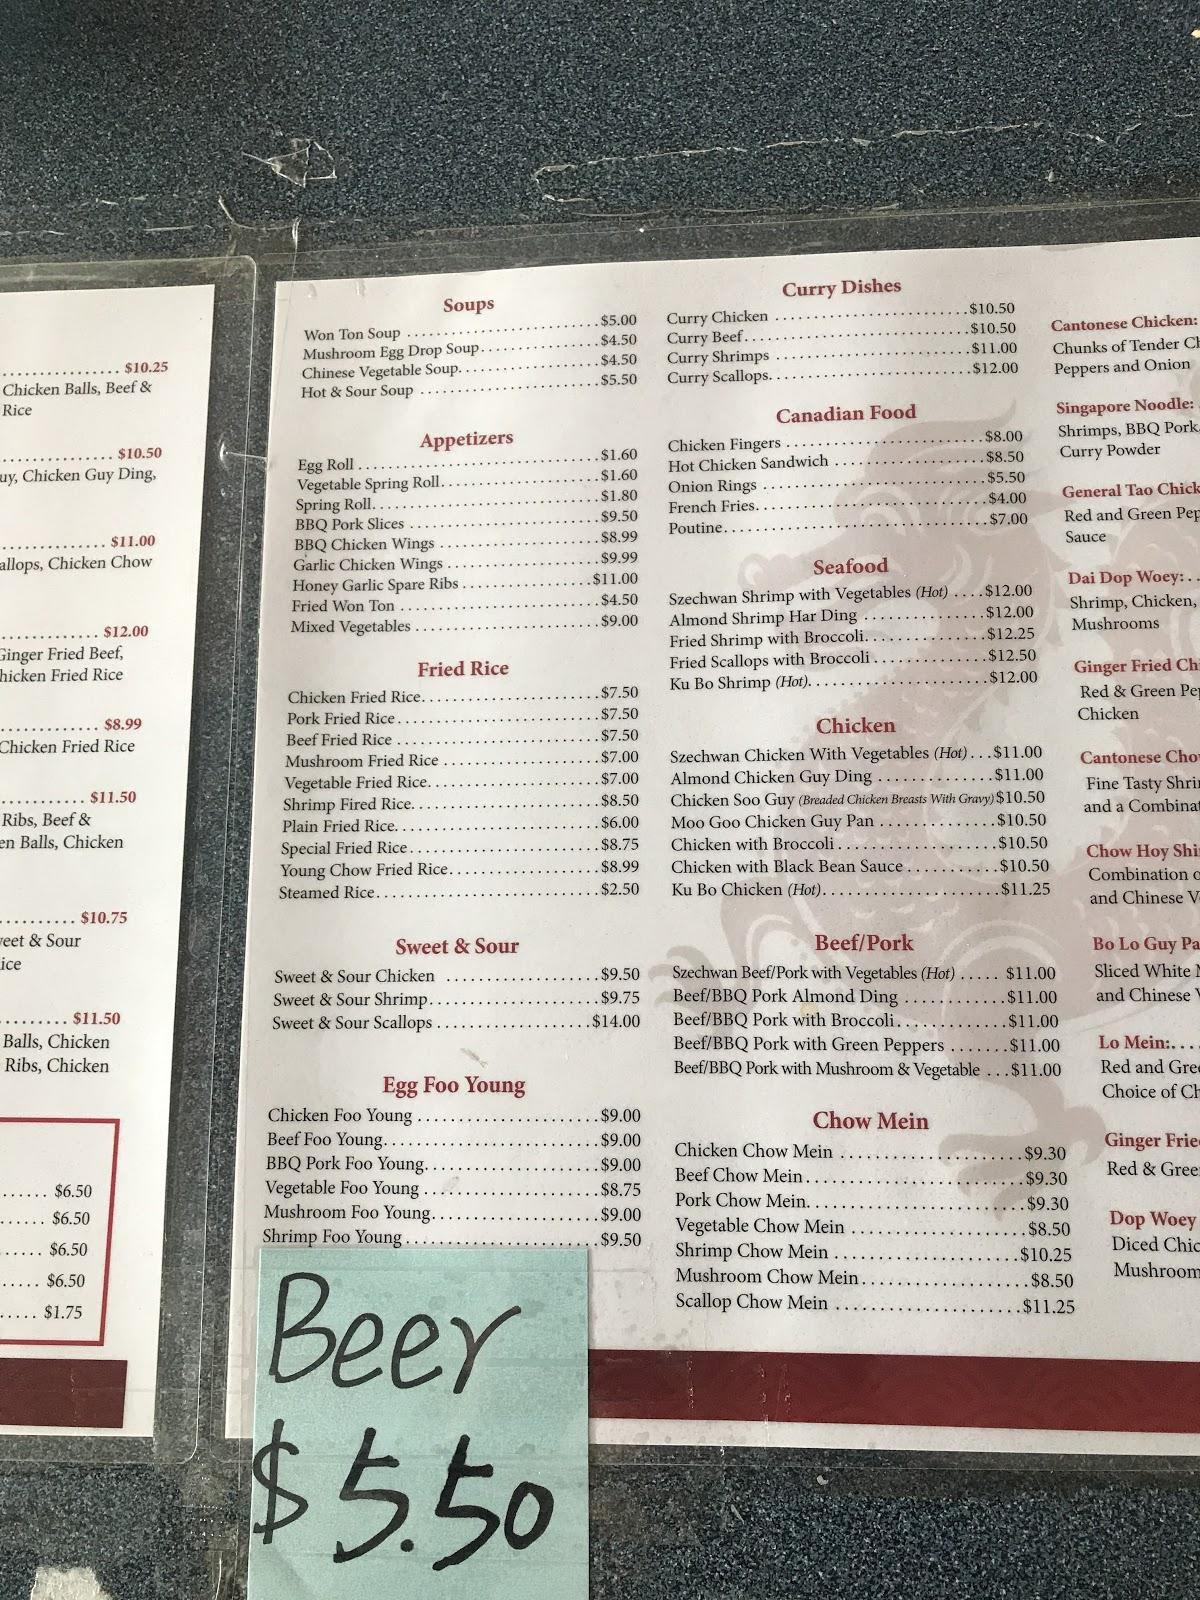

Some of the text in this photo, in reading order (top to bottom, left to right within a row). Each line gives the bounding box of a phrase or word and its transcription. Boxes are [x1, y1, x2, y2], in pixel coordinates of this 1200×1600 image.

[783, 278, 902, 299] Curry Dishes
[444, 299, 494, 315] Soups
[667, 302, 1015, 327] Curry Chicken $10.50
[304, 314, 637, 342] Won Ton Soup $5.00
[1051, 314, 1198, 332] Cantonese Chicken:
[303, 334, 637, 361] Mushroom Egg Drop Soup $4.50
[667, 342, 1017, 367] Curry Shrimps $11.00
[125, 362, 168, 374] $10.25
[1054, 359, 1191, 378] Peppers and Onion
[3, 380, 152, 397] Chicken Balls, Beef &
[301, 374, 637, 399] Hot & Sour Soup $5.50
[3, 404, 32, 416] Rice
[777, 404, 917, 424] Canadian Food
[1057, 397, 1194, 417] Singapore Noodle:
[420, 432, 514, 452] Appetizers
[118, 448, 162, 460] $10.50
[1060, 443, 1161, 461] Curry Powder
[298, 449, 638, 475] Egg Roll $1.60
[668, 451, 1024, 473] Hot Chicken Sandwich $8.50
[23, 468, 156, 484] Chicken Guy Ding,
[669, 471, 1025, 495] Onion Rings $5.50
[296, 510, 638, 534] BBQ Pork Slices $9.50
[669, 513, 1028, 535] Poutine $7.00
[111, 535, 155, 548] $11.00
[1066, 531, 1106, 543] Sauce
[814, 557, 889, 575] Seafood
[293, 572, 638, 596] Honey Garlic Spare Ribs $11.00
[1068, 570, 1184, 587] Dai Dop Woey:
[291, 614, 639, 637] Mixed Vegetables $9.00
[669, 606, 1034, 627] Almond Shrimp Har Ding $12.00
[1072, 617, 1160, 631] Mushrooms
[104, 625, 149, 638] $12.00
[418, 661, 509, 677] Fried Rice
[670, 670, 1038, 692] Ku Bo Shrimp (Hot) $12.00
[288, 686, 639, 704] Chicken Fried Rice $7.50
[1078, 706, 1140, 721] Chicken
[105, 718, 142, 731] $8.99
[817, 717, 897, 735] Chicken
[91, 791, 136, 804] $11.50
[284, 794, 639, 815] Shrimp Fired Rice $8.50
[671, 813, 1047, 832] Moo Goo Chicken Guy Pan $10.50
[279, 882, 640, 900] Steamed Rice $2.50
[81, 911, 127, 925] $10.75
[396, 938, 520, 955] Sweet & Sour
[815, 933, 914, 952] Beef/Pork
[73, 1012, 121, 1025] $11.50
[273, 1014, 640, 1033] Sweet & Sour Scallops $14.00
[673, 1035, 1060, 1057] Beef/BBQ Pork with Green Peppers $11.00
[1099, 1035, 1170, 1050] Lo Mein:
[383, 1076, 526, 1099] Egg Foo Young
[813, 1111, 930, 1130] Chow Mein
[266, 1155, 641, 1176] BBQ Pork Foo Young $9.00
[55, 1184, 92, 1199] $6.50
[53, 1211, 90, 1226] $6.50
[675, 1217, 1071, 1238] Vegetable Chow Mein $8.50
[44, 1304, 82, 1320] $1.75
[676, 1292, 1075, 1315] Scallop Chow Mein $11.25
[269, 1272, 522, 1395] Beer
[253, 1419, 554, 1571] $5.50
